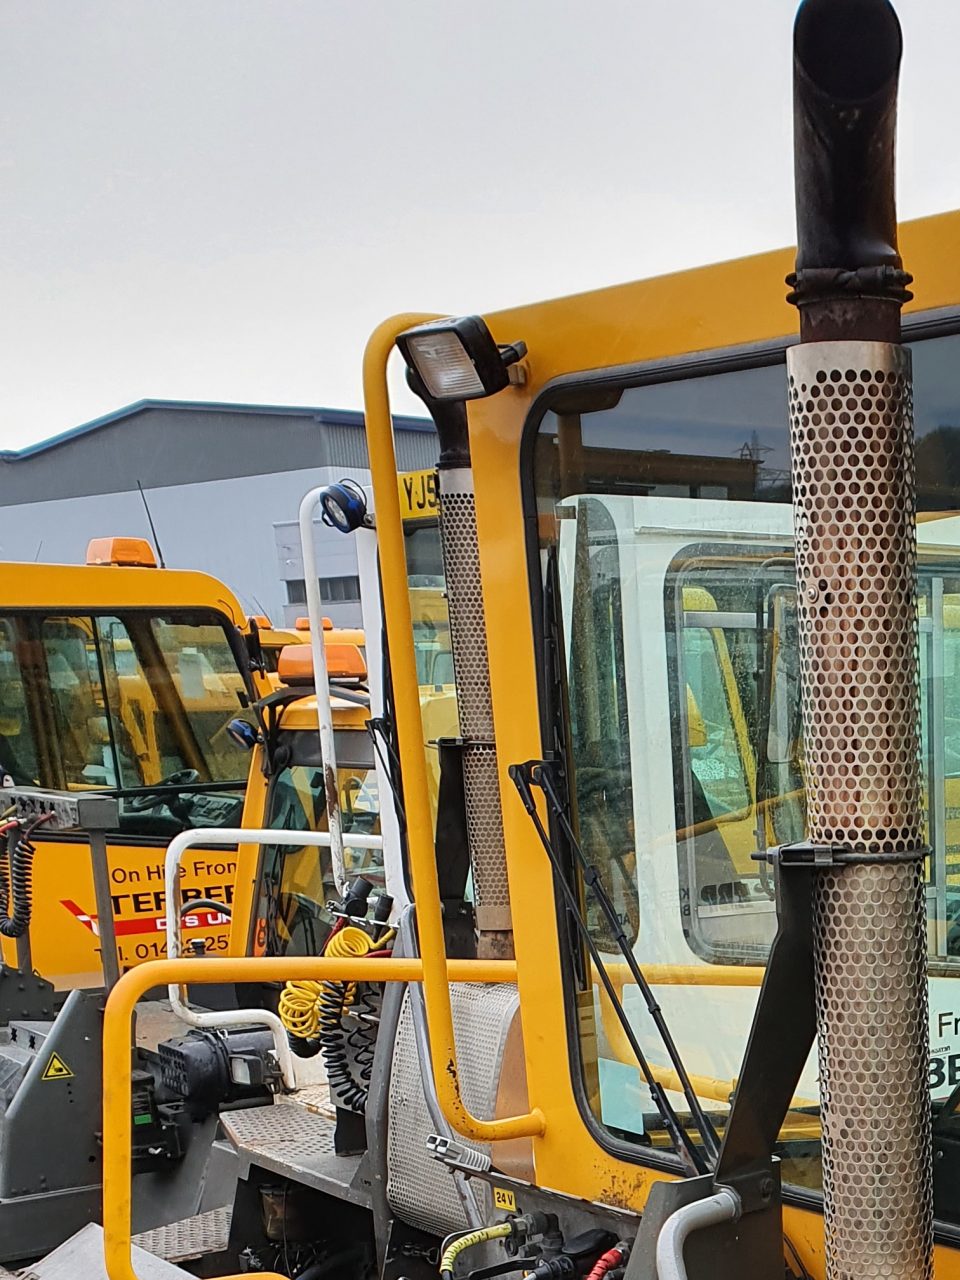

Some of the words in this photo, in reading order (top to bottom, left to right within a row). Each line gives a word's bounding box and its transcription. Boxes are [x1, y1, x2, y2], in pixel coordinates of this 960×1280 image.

[112, 868, 140, 884] On
[146, 863, 186, 880] Hie
[496, 1192, 507, 1204] 24
[507, 1194, 513, 1206] V
